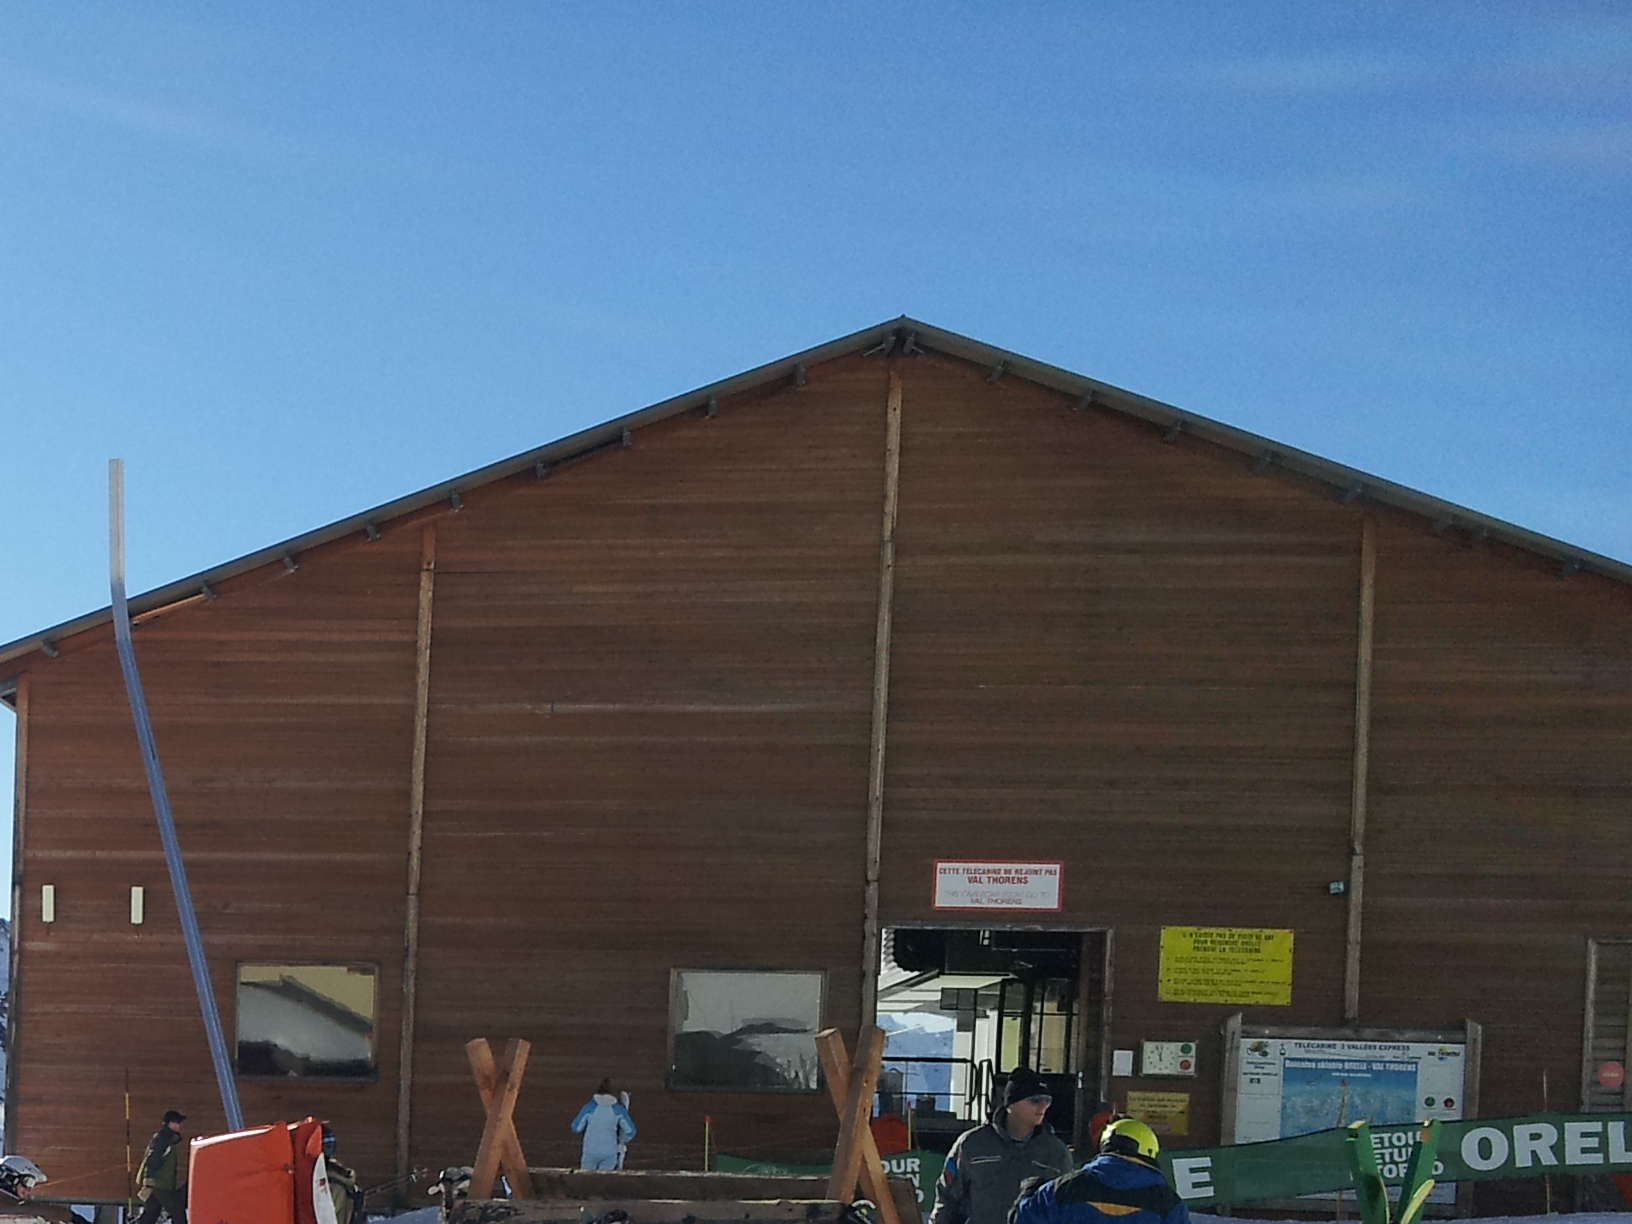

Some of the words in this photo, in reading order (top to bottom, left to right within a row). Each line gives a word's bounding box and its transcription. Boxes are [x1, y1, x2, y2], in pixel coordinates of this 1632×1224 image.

[939, 867, 960, 875] CETTE
[1045, 868, 1057, 876] PAS
[968, 876, 983, 884] VAL
[987, 876, 1029, 884] THORENS
